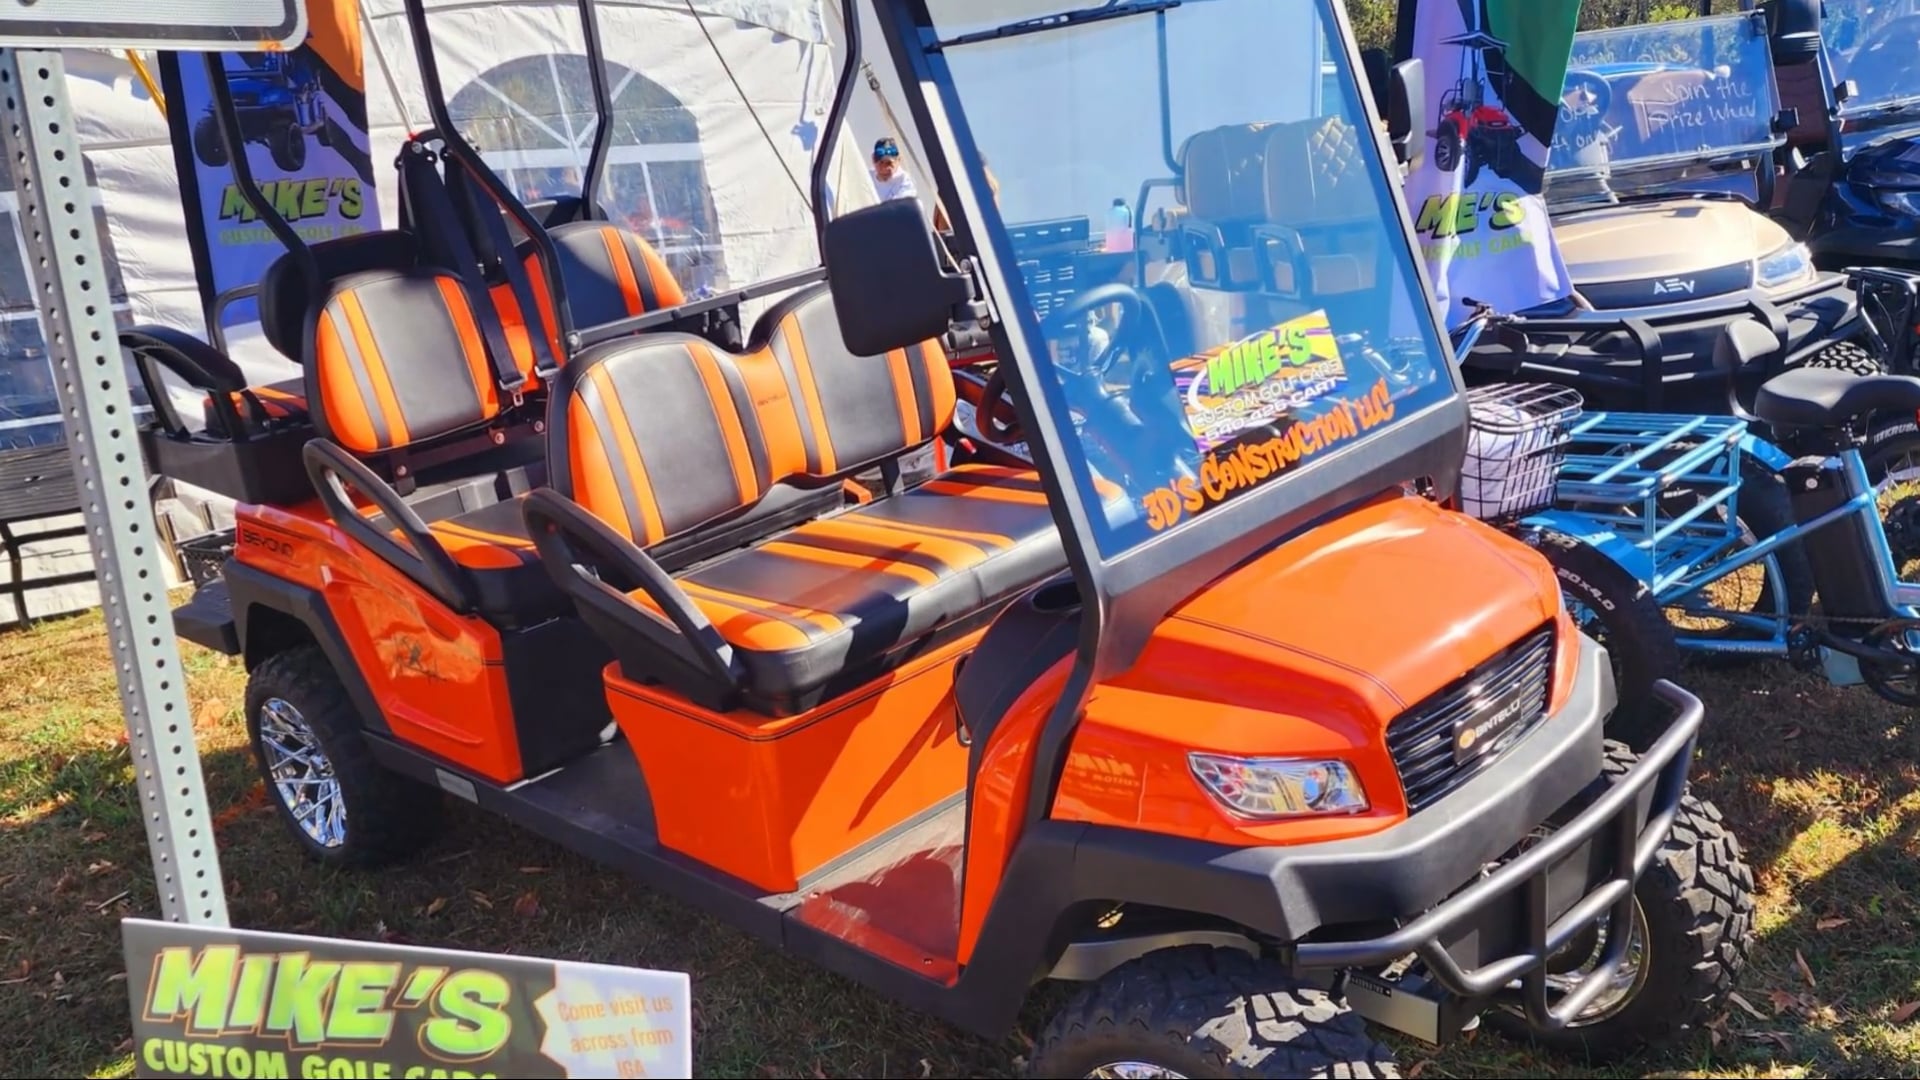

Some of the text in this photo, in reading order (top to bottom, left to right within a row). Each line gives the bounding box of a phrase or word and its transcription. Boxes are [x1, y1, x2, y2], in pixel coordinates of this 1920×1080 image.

[1715, 77, 1752, 101] the
[1653, 278, 1695, 294] AEV
[1206, 328, 1312, 396] MIKE'S
[1193, 358, 1339, 428] CUSTOM GOLF CARS
[1143, 475, 1204, 531] 3D'S
[143, 945, 511, 1063] MIKE'S
[557, 997, 674, 1023] Come visit us
[143, 1038, 290, 1079] CUSTOM
[570, 1026, 674, 1054] across from
